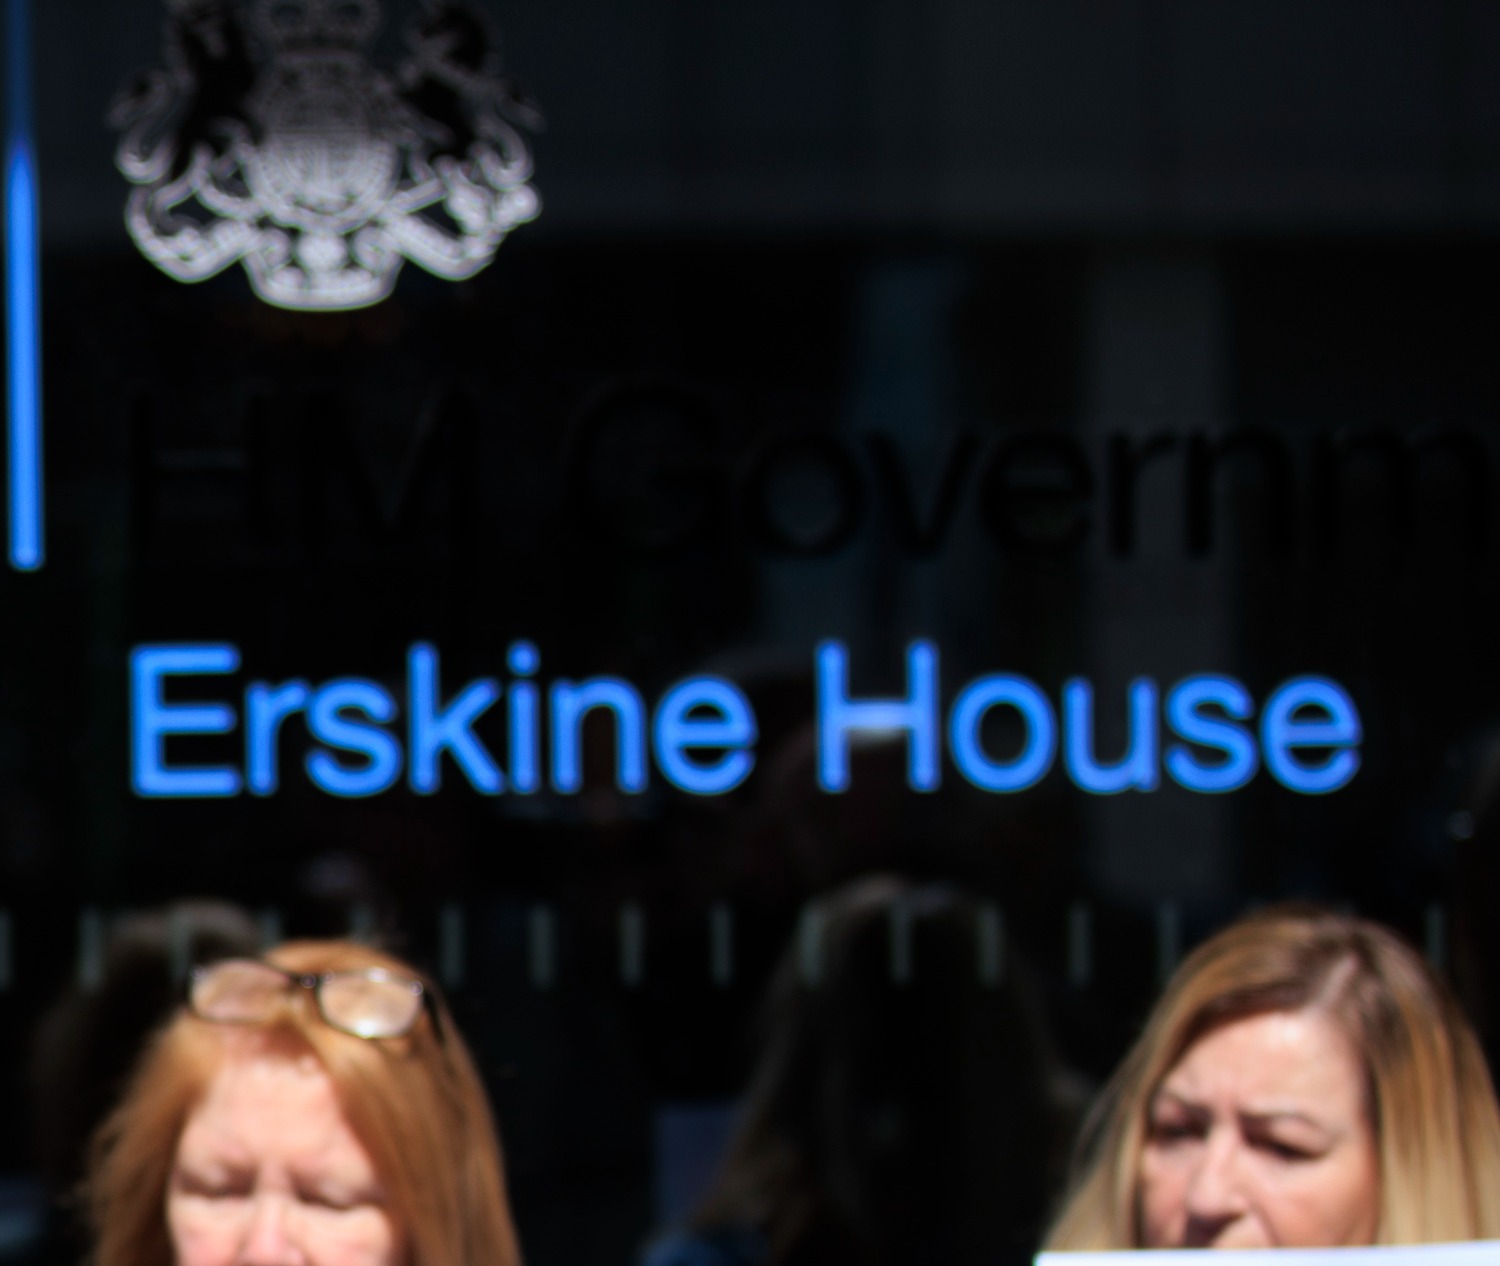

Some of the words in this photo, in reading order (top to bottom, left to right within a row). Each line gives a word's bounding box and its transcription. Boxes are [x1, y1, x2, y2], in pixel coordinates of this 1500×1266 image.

[130, 378, 480, 554] HM
[129, 641, 758, 797] Erskine
[815, 641, 1363, 795] House
